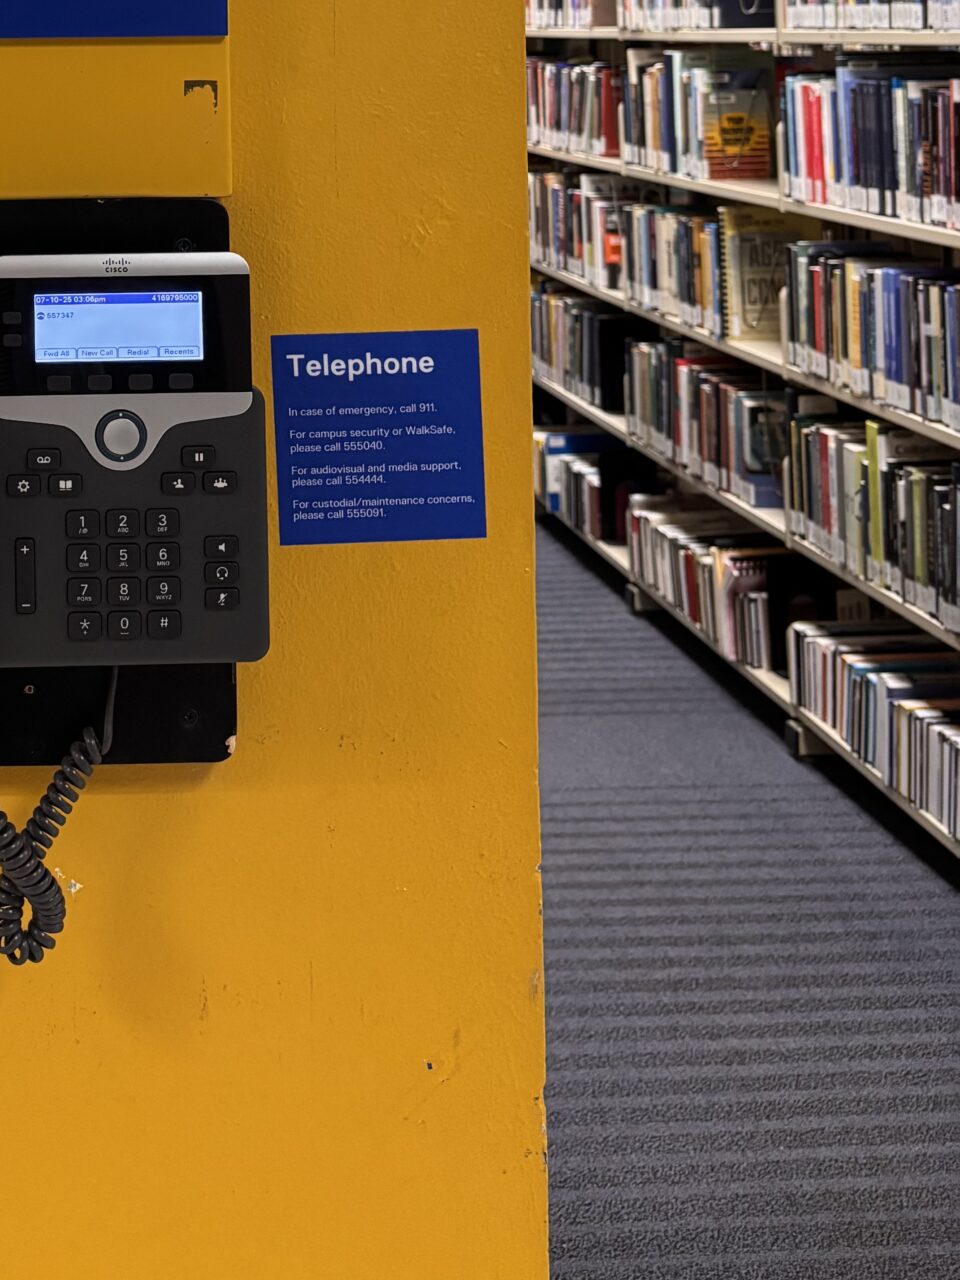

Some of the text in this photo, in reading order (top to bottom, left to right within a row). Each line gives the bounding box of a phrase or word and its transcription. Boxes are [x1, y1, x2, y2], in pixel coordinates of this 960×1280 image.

[35, 295, 106, 304] 07-10-25 03:06pm
[99, 349, 114, 357] Call
[127, 348, 150, 356] Redial
[286, 352, 435, 382] Telephone
[288, 403, 438, 417] In case of emergency, call 911.
[289, 429, 306, 439] For
[308, 429, 347, 440] campus
[349, 427, 390, 438] security
[392, 427, 403, 436] or
[290, 440, 386, 455] please call 555040.
[291, 465, 308, 475] For
[310, 464, 365, 475] audiovisual
[367, 463, 386, 473] and
[388, 462, 418, 472] media
[291, 475, 387, 488] please call 554444.
[292, 499, 309, 509] For
[311, 496, 425, 509] custodial/maintenance
[119, 515, 128, 527] 2
[158, 514, 168, 526] 3
[293, 508, 387, 523] please call 555091.
[79, 516, 85, 528] 1
[79, 550, 89, 561] 4
[119, 549, 128, 561] 5
[159, 548, 168, 560] 6
[80, 584, 89, 596] 7
[120, 583, 129, 595] 8
[159, 582, 169, 594] 9
[120, 617, 130, 629] 0
